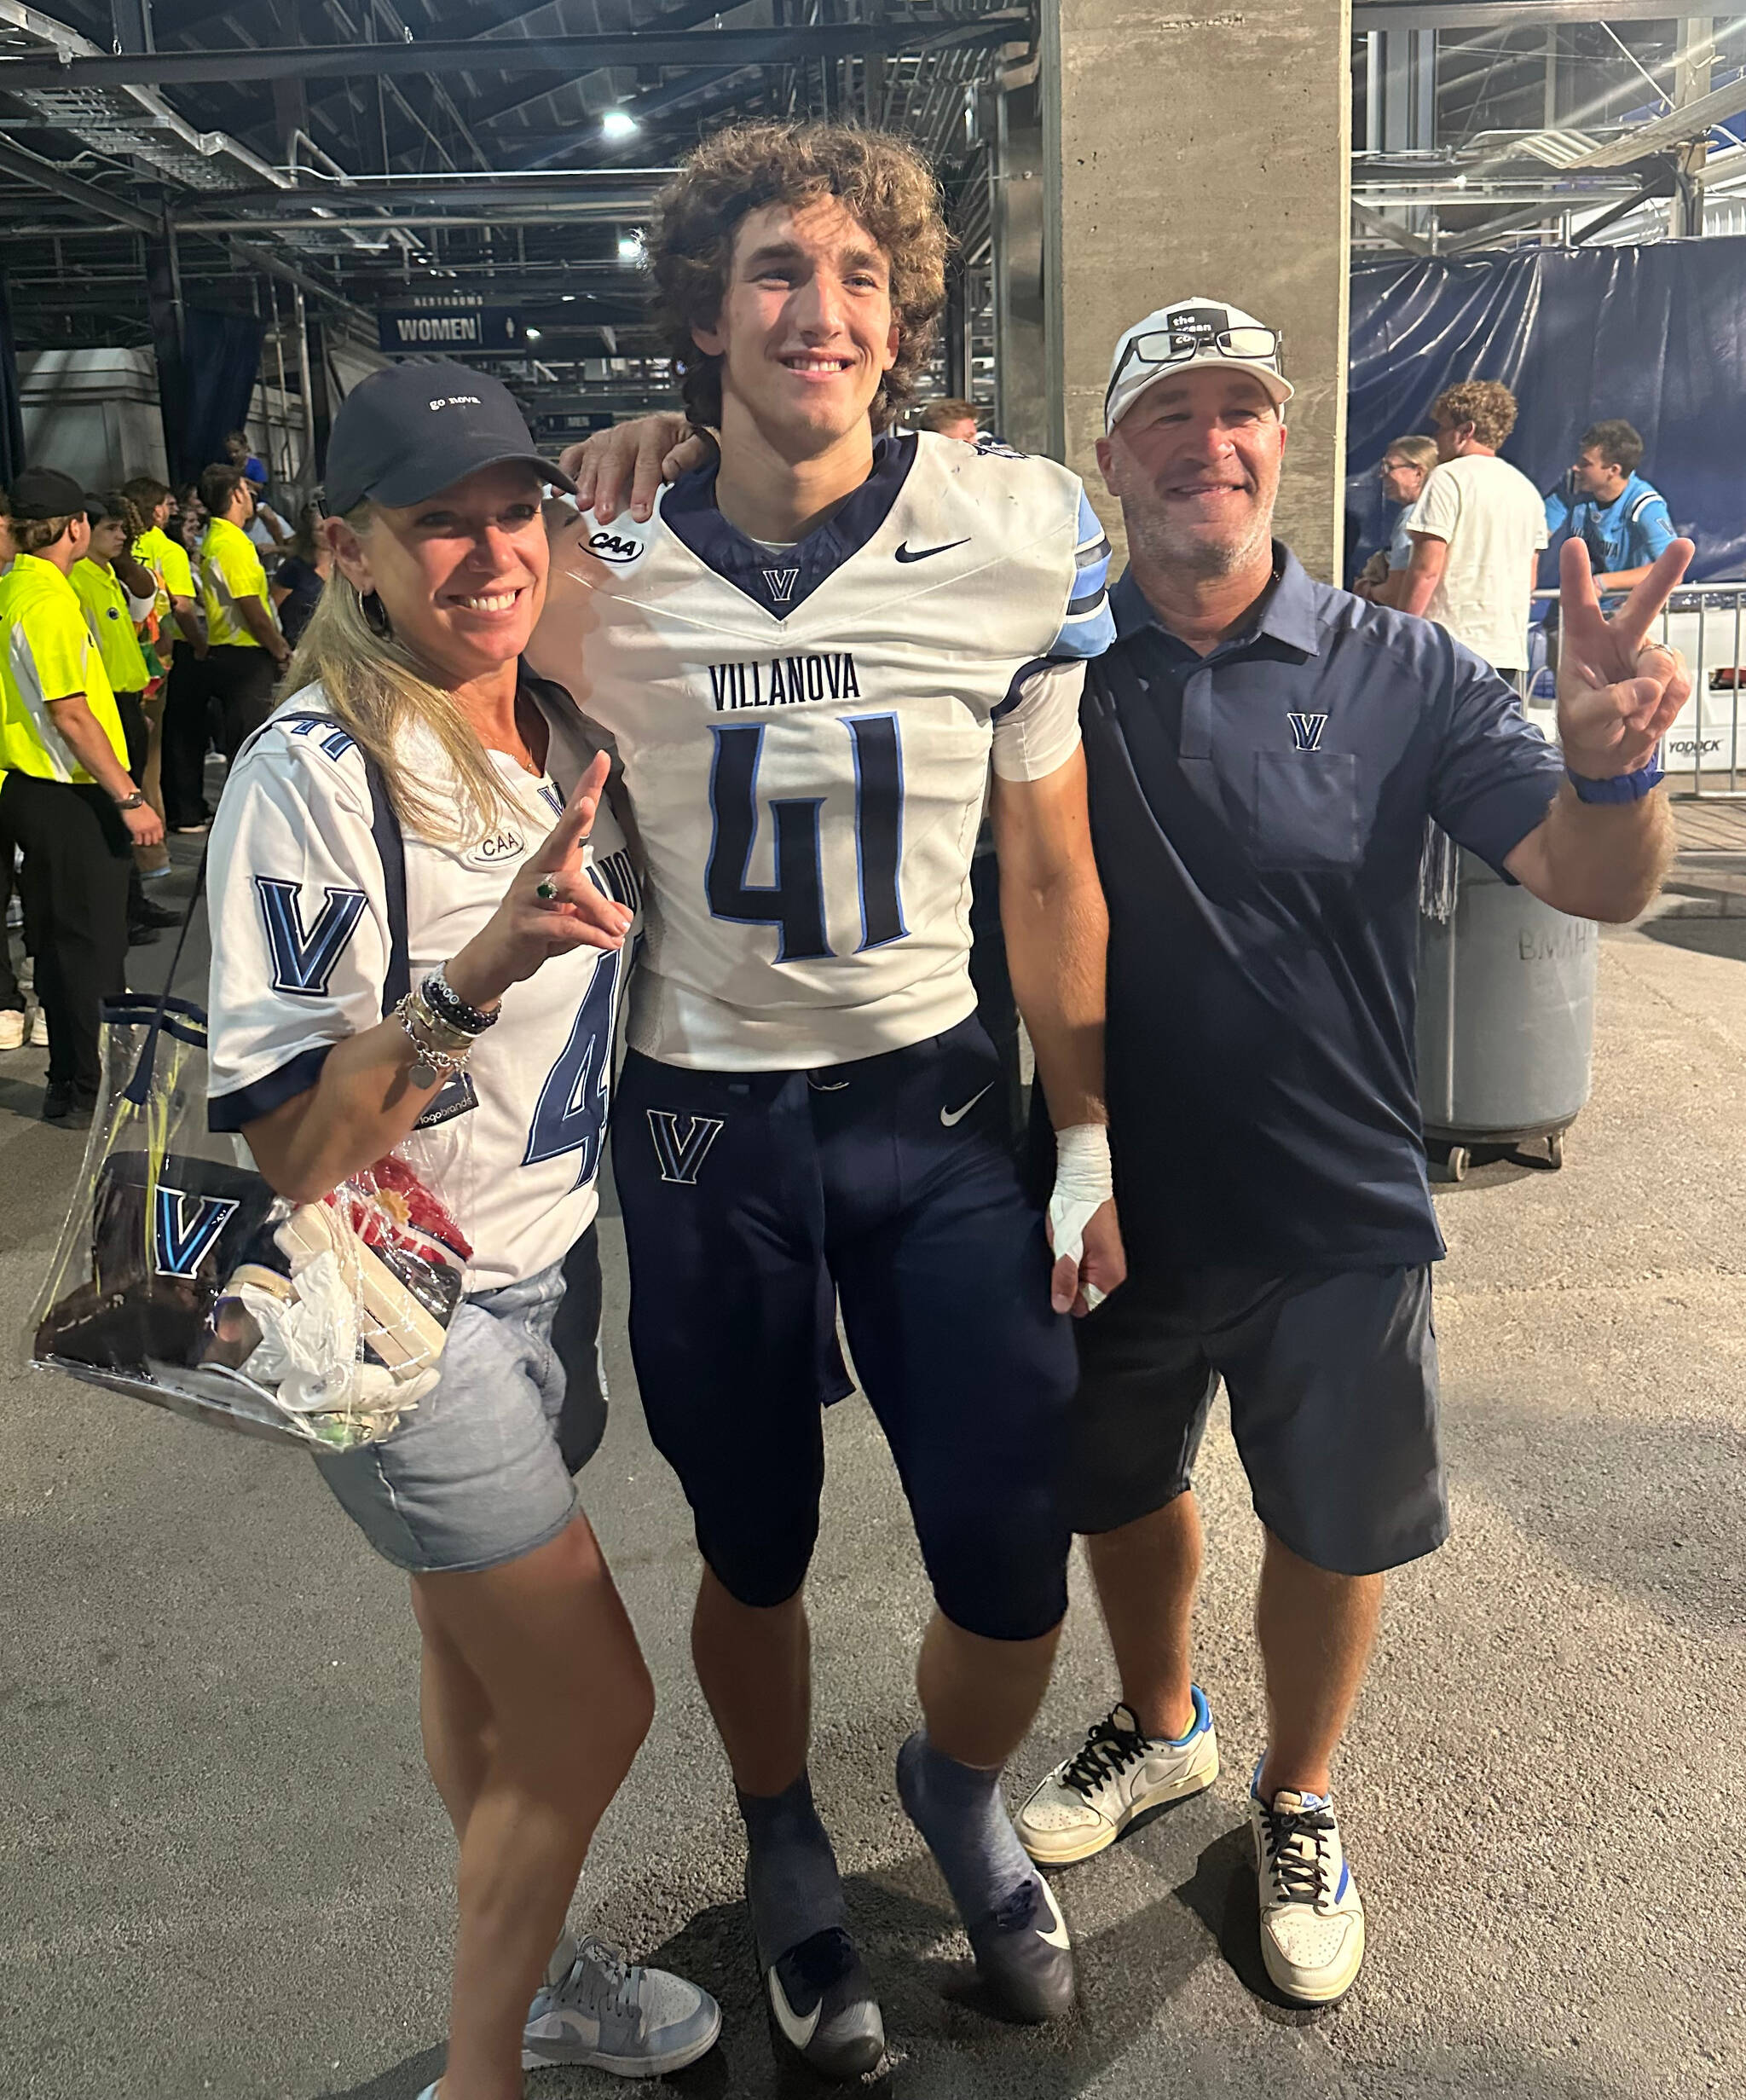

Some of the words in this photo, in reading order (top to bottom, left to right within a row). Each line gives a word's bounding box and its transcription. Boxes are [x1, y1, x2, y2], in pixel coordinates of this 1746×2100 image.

[396, 318, 477, 341] WOMEN
[1172, 315, 1194, 326] the
[429, 399, 446, 410] go
[589, 533, 636, 556] CAA
[763, 568, 799, 601] V
[708, 653, 861, 711] VILLANOVA
[1286, 712, 1328, 751] V
[1668, 738, 1724, 754] YODOCK
[483, 832, 519, 856] CAA
[704, 711, 912, 964] 41
[255, 874, 369, 997] V
[420, 1097, 473, 1125] logobrands
[647, 1108, 724, 1184] V
[154, 1183, 240, 1279] V
